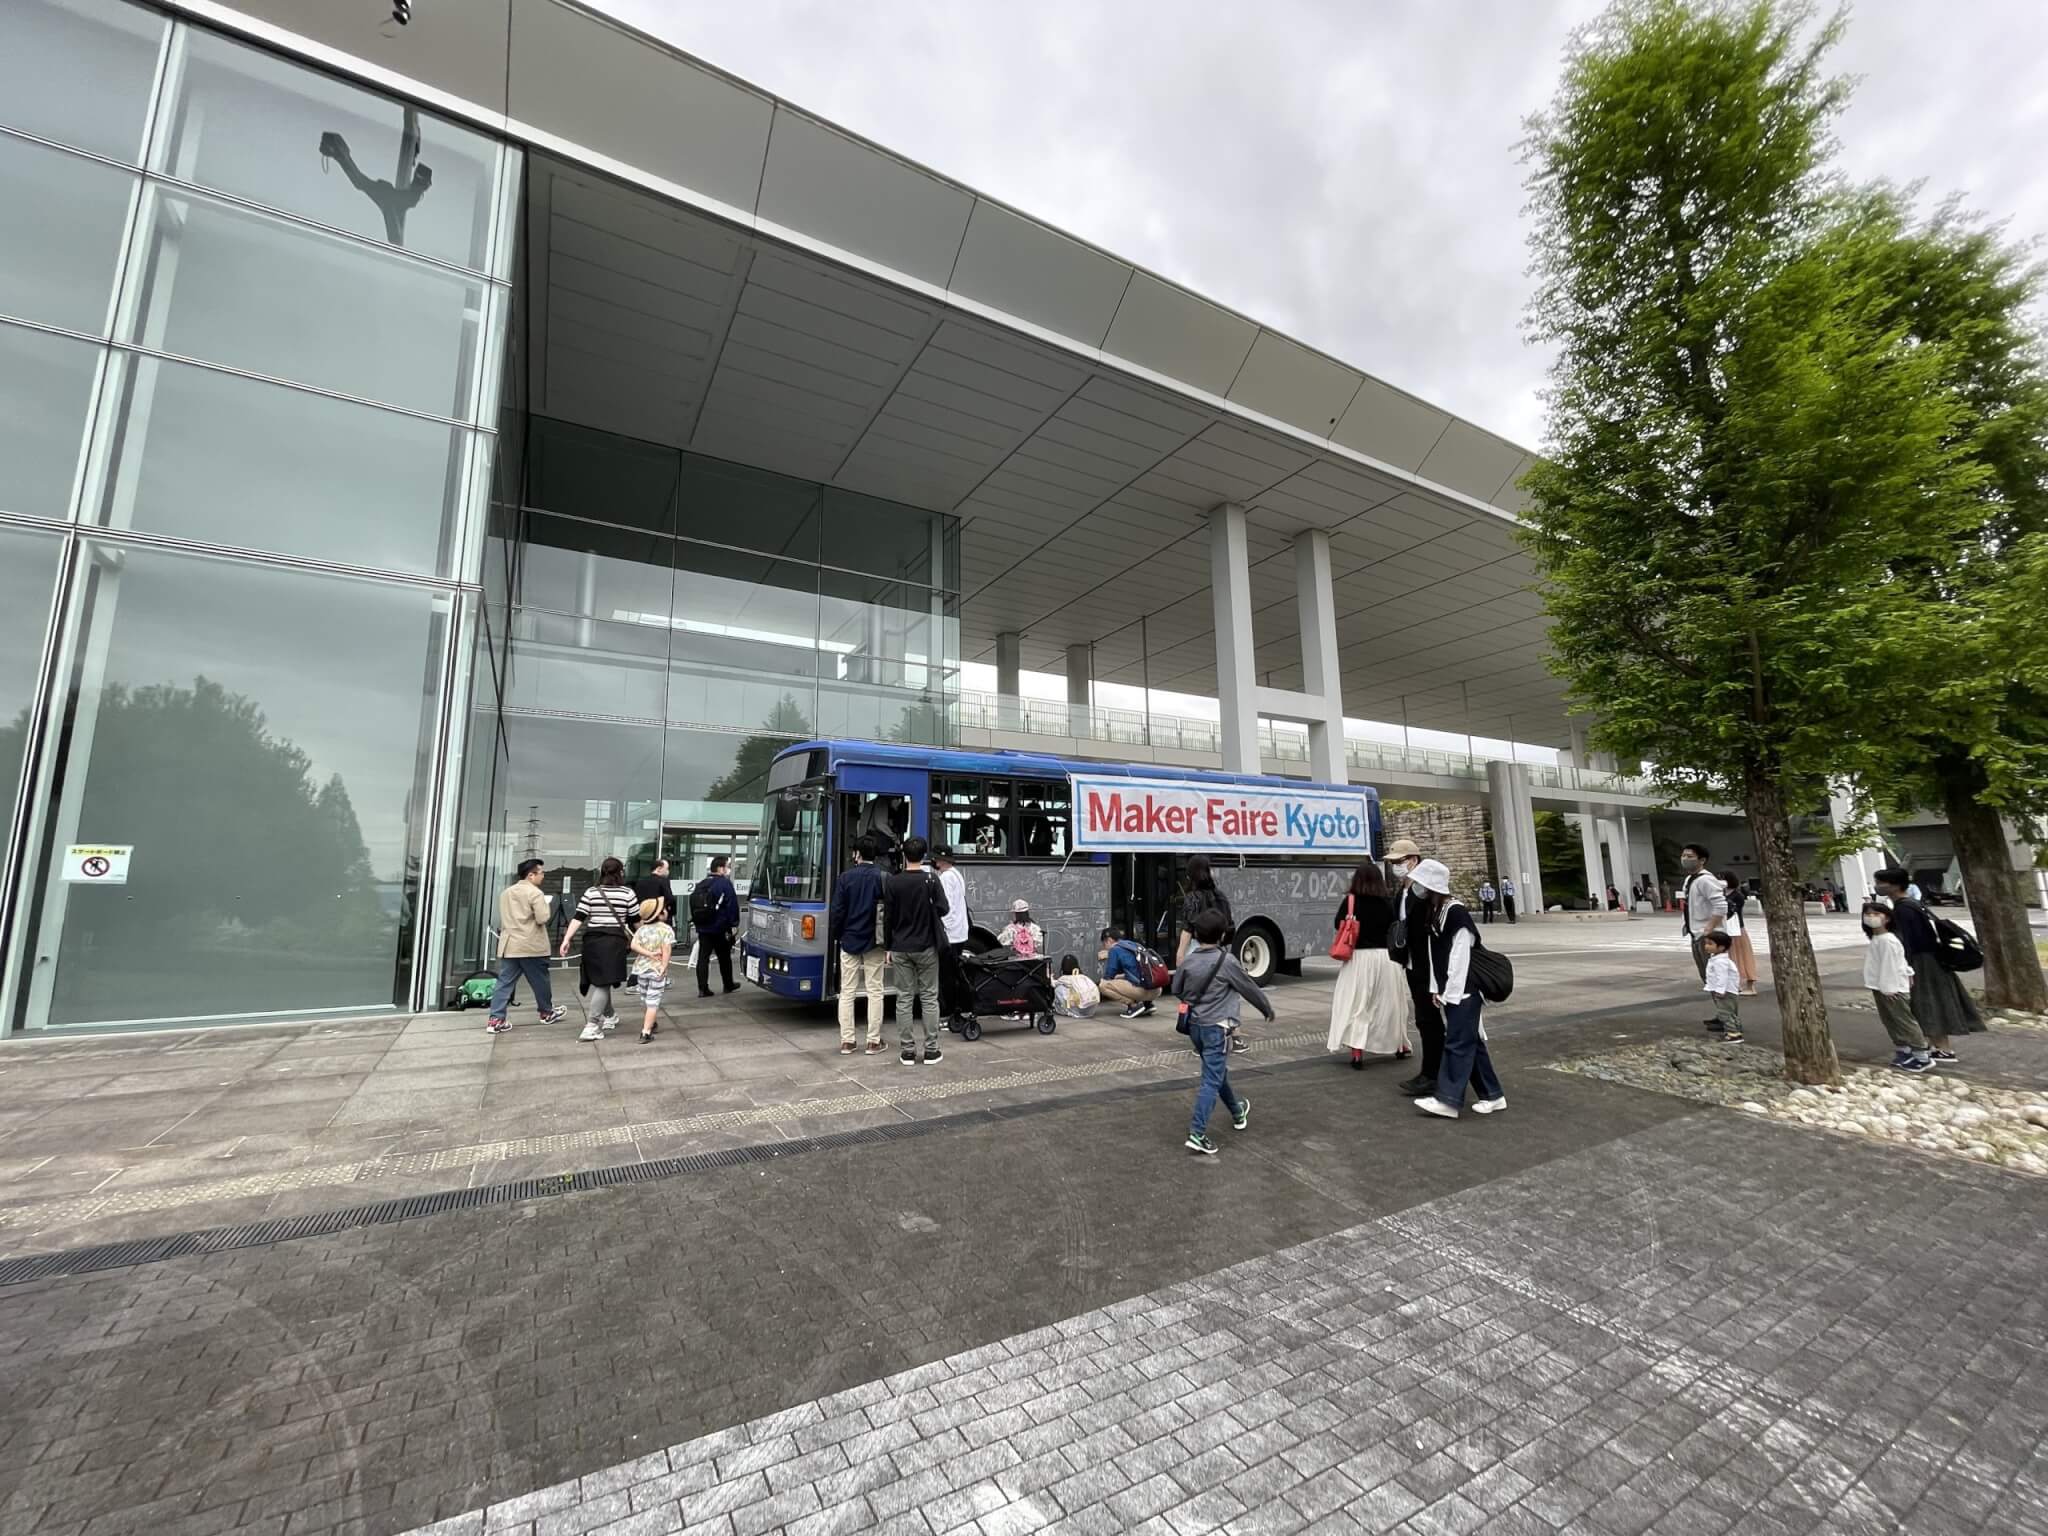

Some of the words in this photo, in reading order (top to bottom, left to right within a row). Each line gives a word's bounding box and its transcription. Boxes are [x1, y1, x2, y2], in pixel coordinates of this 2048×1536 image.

[1088, 792, 1198, 834] Maker
[1206, 798, 1279, 837] Faire
[1285, 802, 1360, 848] Kyoto
